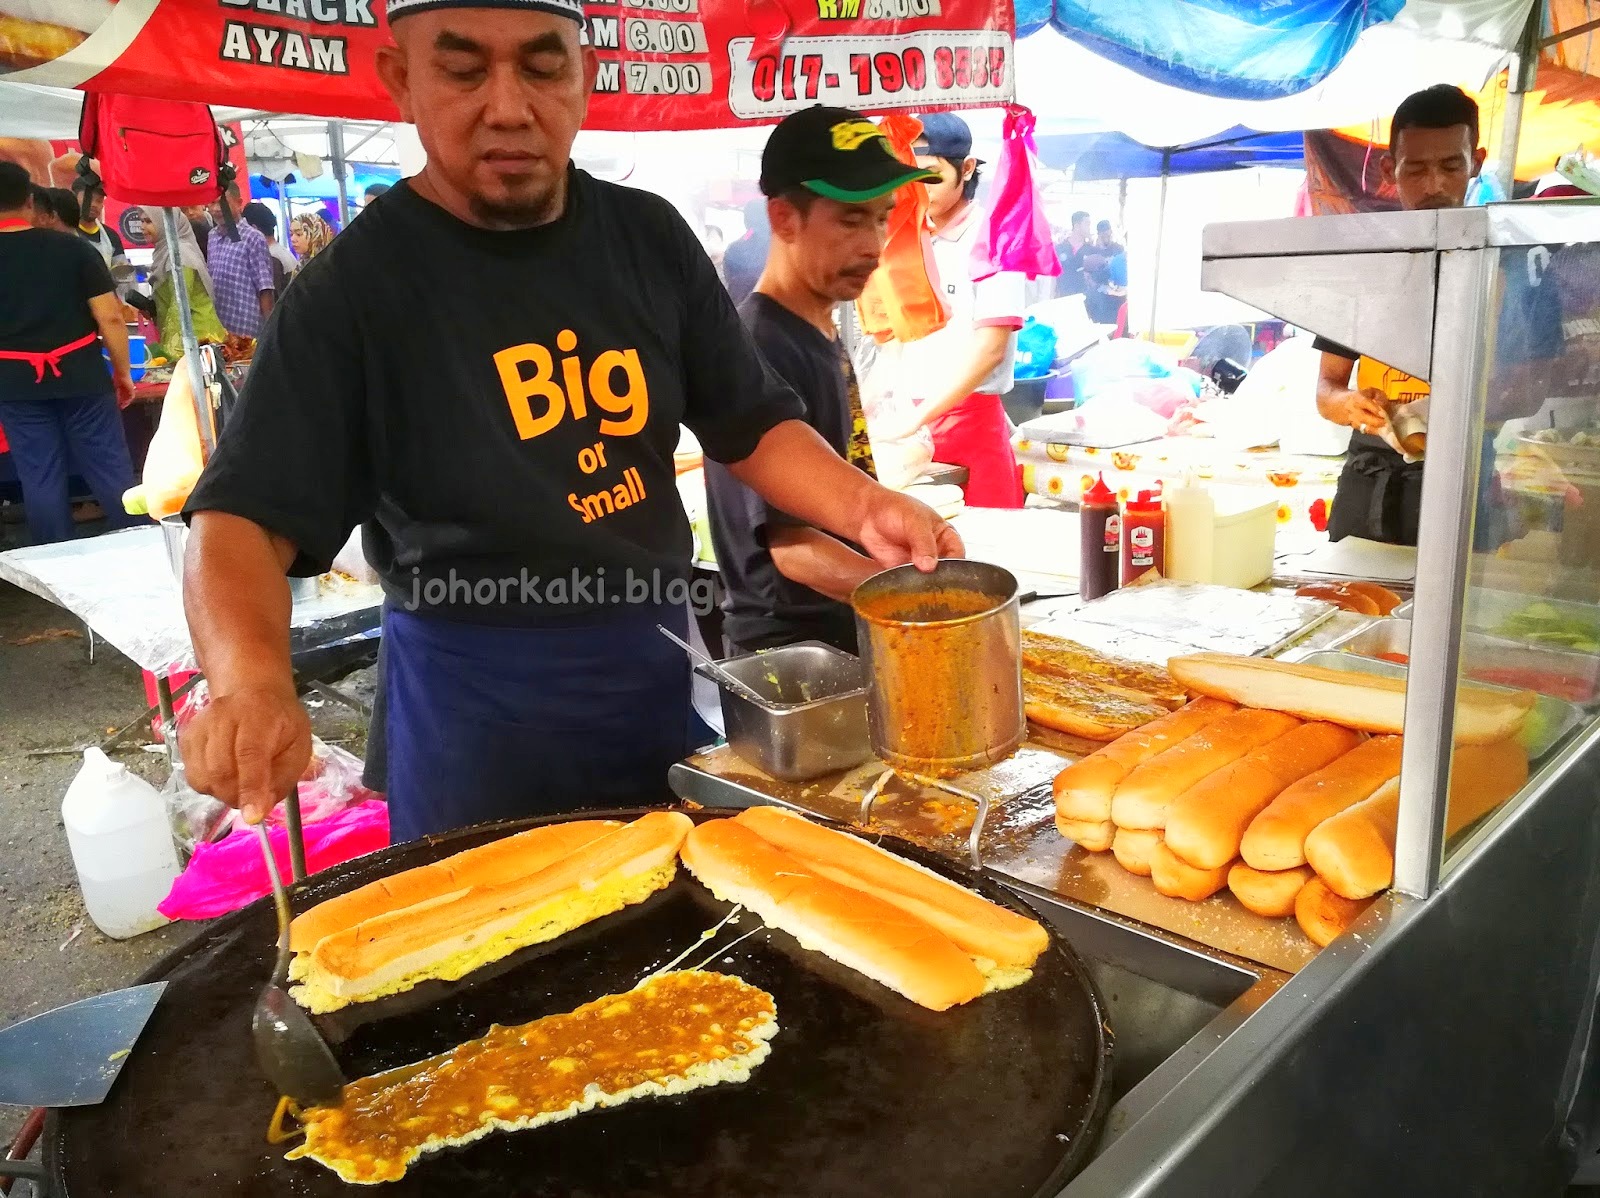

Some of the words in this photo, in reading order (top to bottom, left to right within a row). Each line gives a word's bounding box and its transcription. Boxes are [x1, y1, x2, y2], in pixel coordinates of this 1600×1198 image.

[220, 0, 377, 26] ACK
[221, 22, 348, 74] AYAM
[629, 20, 696, 52] 6.00
[630, 63, 700, 94] 7.00
[850, 46, 926, 96] 790
[493, 329, 649, 440] Big
[577, 441, 607, 474] or
[568, 466, 646, 523] Small
